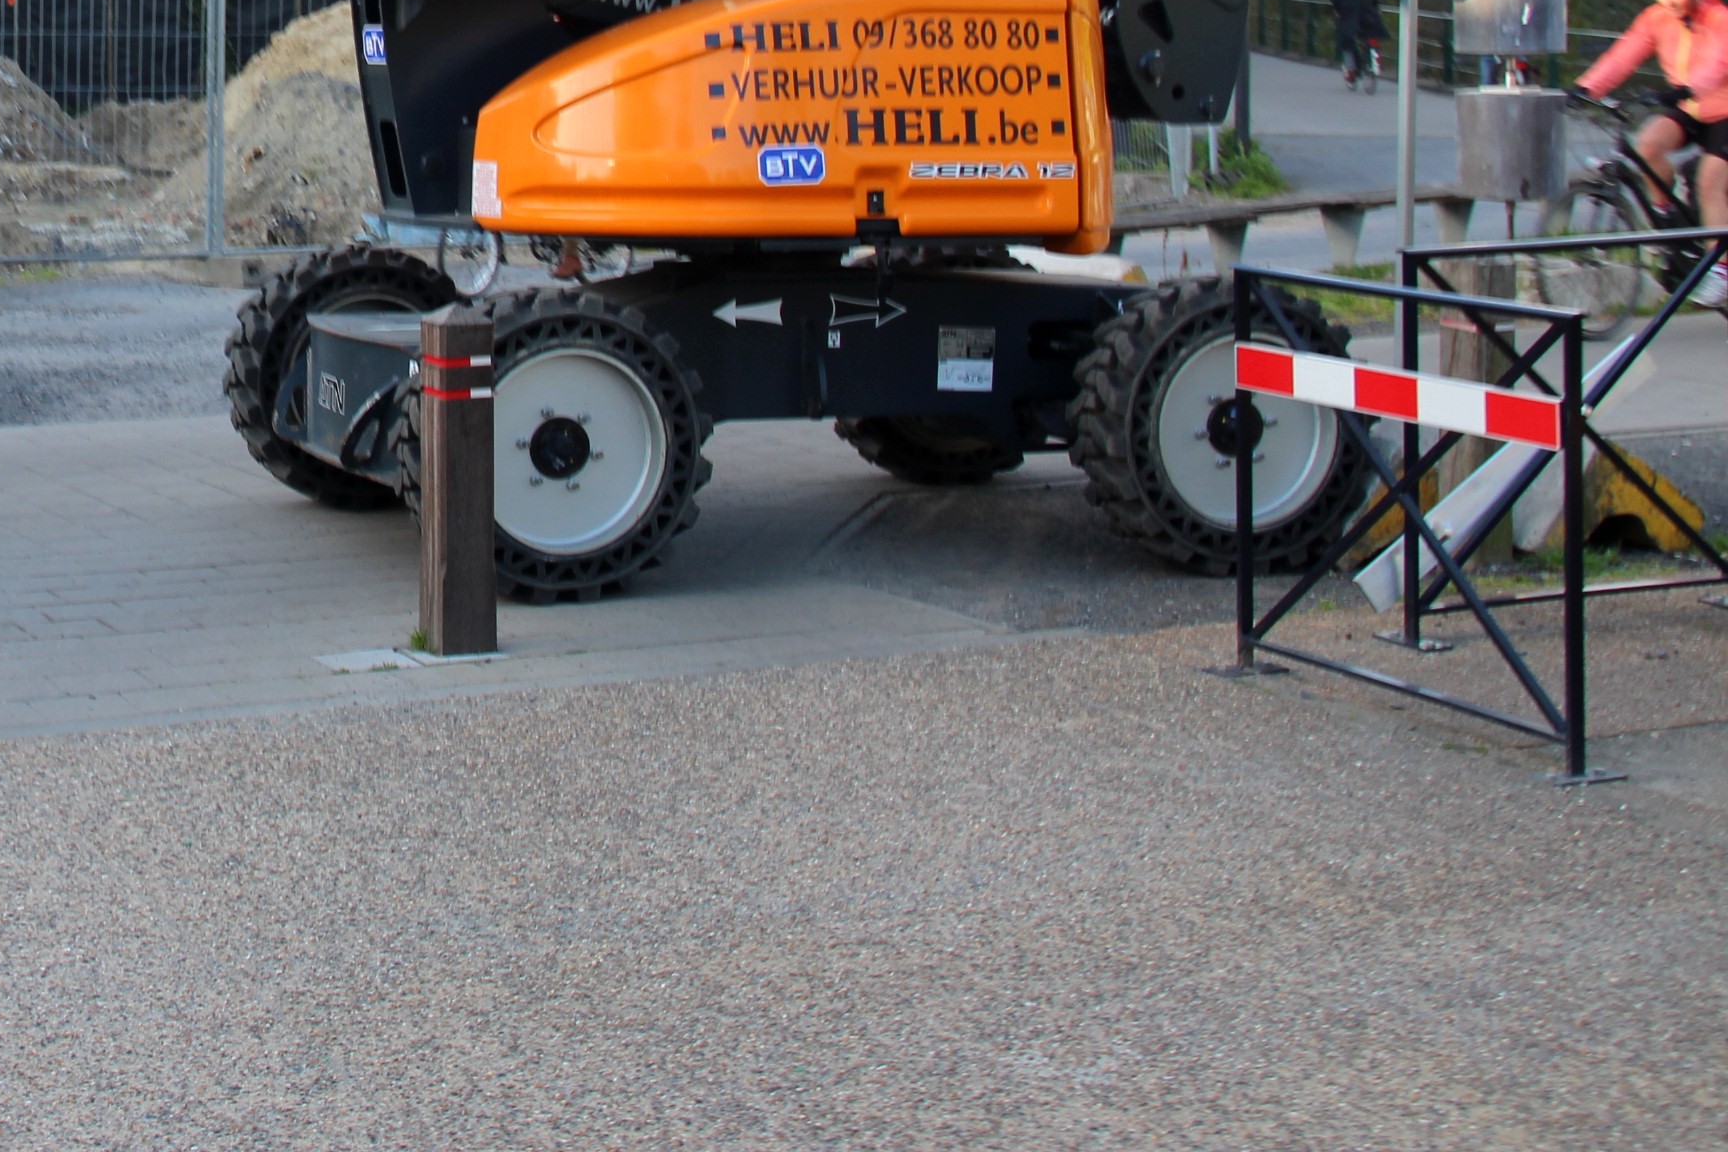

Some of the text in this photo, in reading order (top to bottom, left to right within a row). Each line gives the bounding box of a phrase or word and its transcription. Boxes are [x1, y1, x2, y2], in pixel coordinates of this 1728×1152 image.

[730, 17, 1040, 53] HELI 09/368 80 80
[739, 107, 1039, 147] www.HELI.be
[765, 150, 818, 179] BTV
[909, 161, 1076, 180] ZEBRA 12
